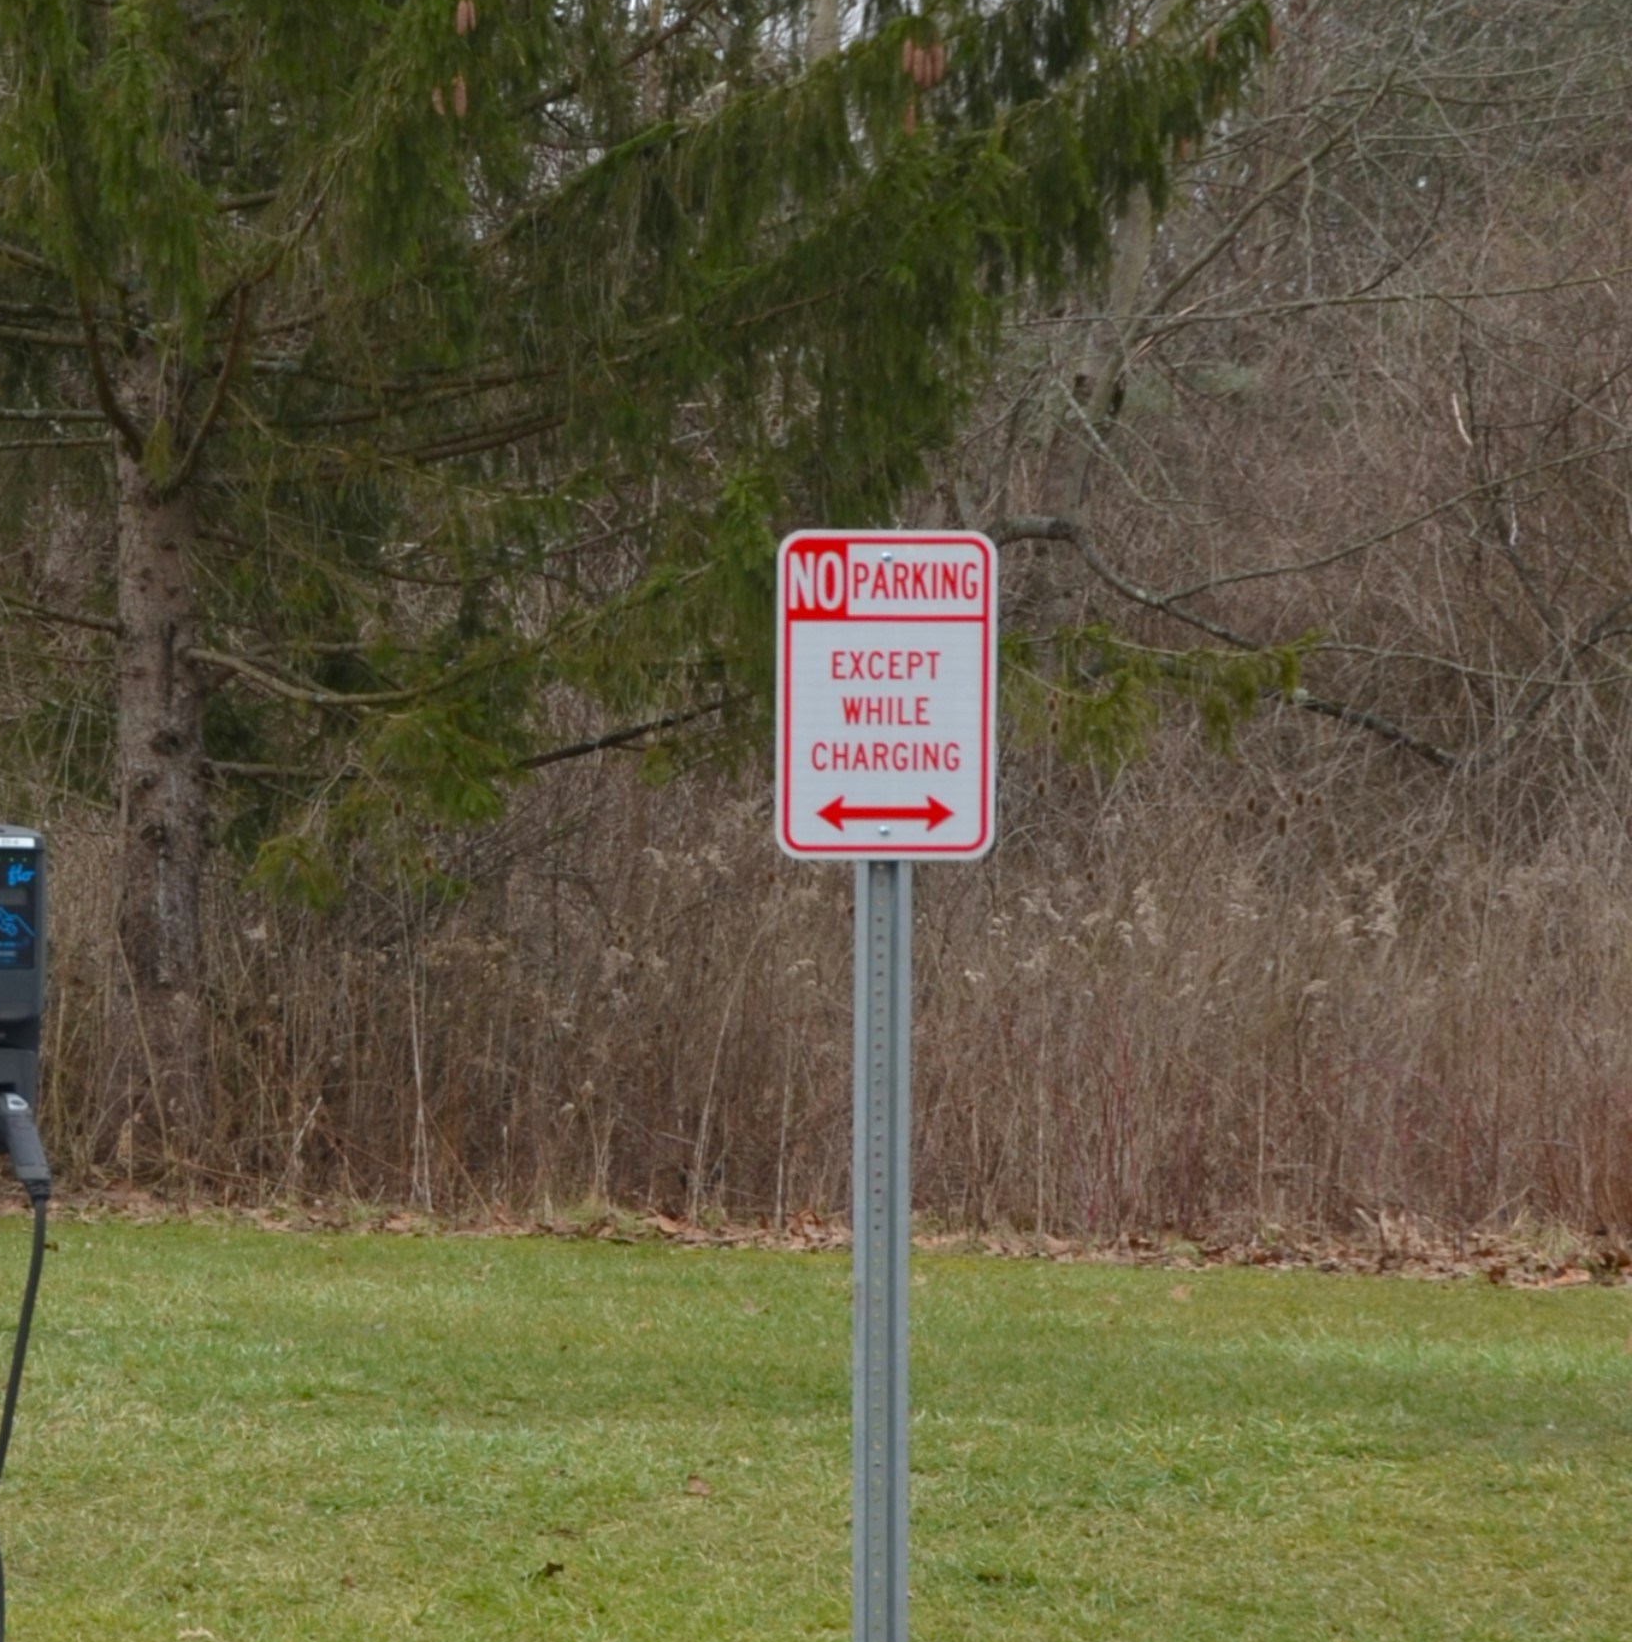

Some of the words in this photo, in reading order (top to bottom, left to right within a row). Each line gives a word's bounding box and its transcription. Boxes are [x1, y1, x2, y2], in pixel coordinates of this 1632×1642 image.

[789, 551, 843, 610] NO
[852, 561, 979, 601] PARKING
[831, 651, 940, 680] EXCEPT
[842, 697, 930, 726] WHILE
[811, 742, 960, 772] CHARGING
[7, 863, 36, 886] flo
